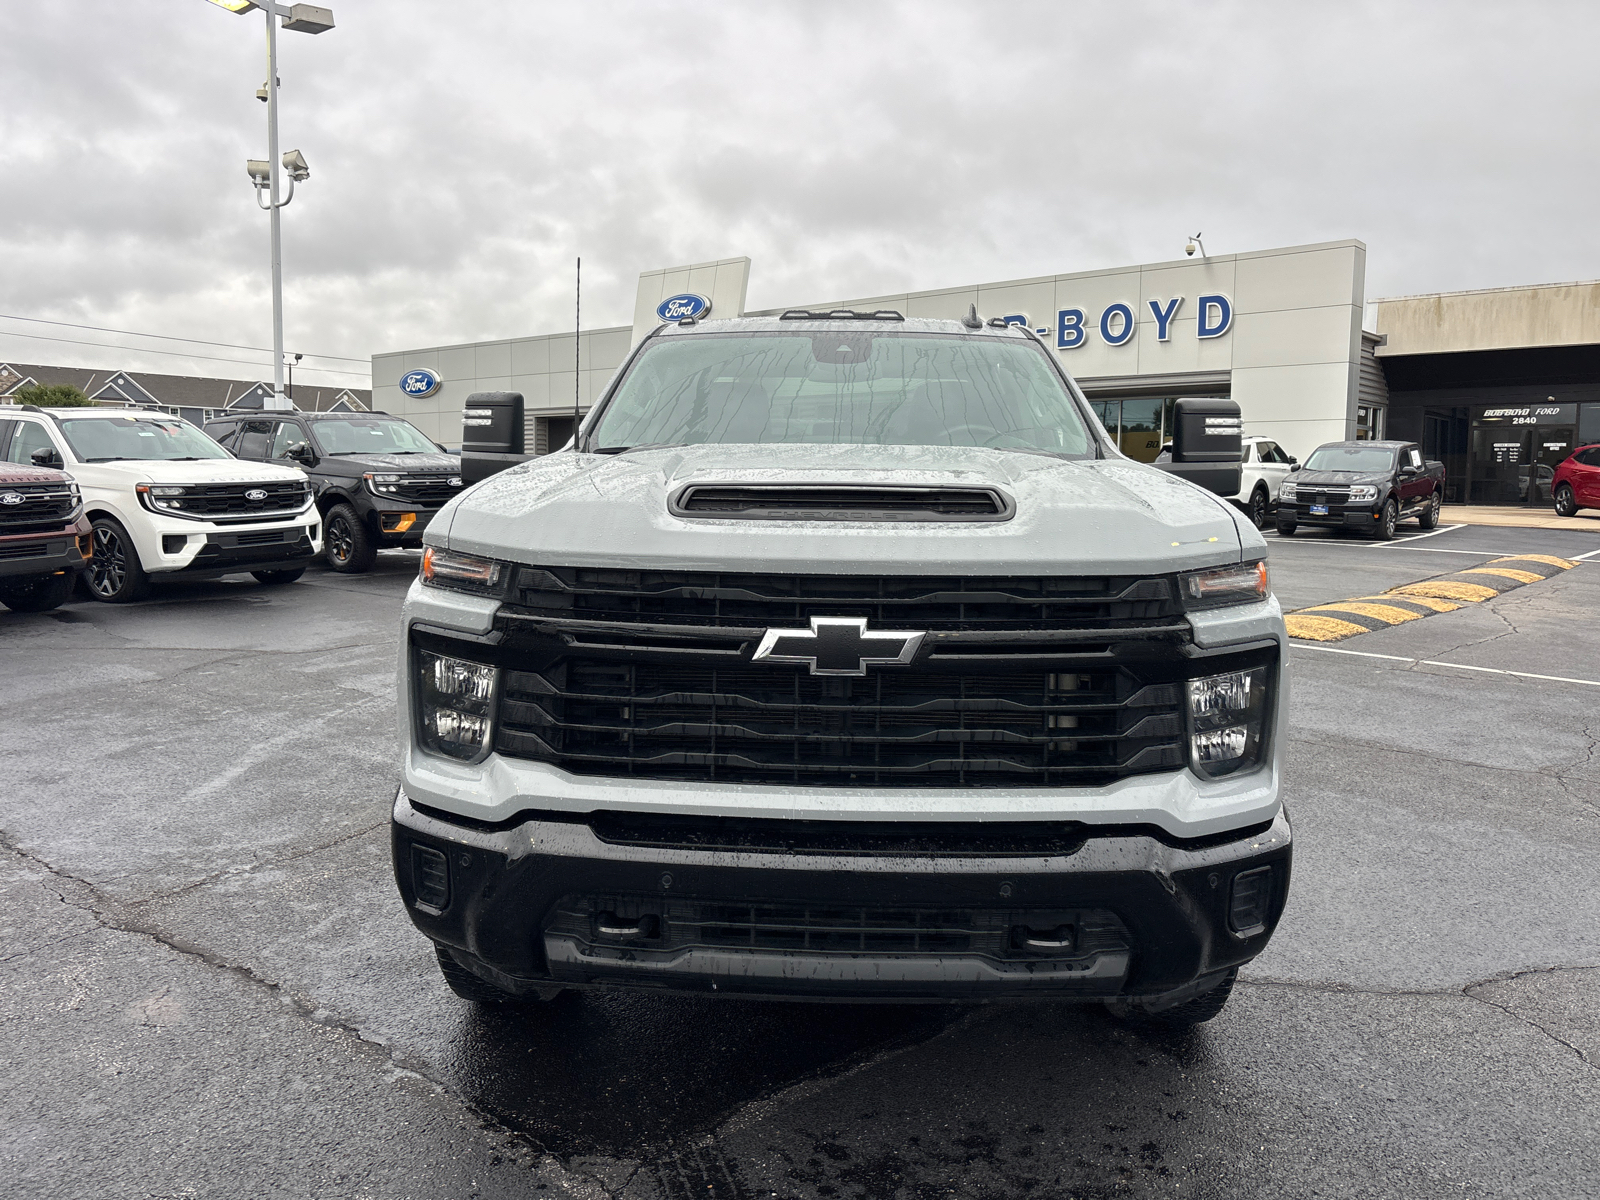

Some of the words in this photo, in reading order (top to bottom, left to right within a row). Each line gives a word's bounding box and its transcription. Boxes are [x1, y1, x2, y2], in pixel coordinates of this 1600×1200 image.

[665, 299, 695, 317] Ford
[405, 375, 428, 391] Ford
[1535, 407, 1560, 415] FORD
[1512, 416, 1537, 425] 2840
[767, 510, 914, 520] CHEVROLET
